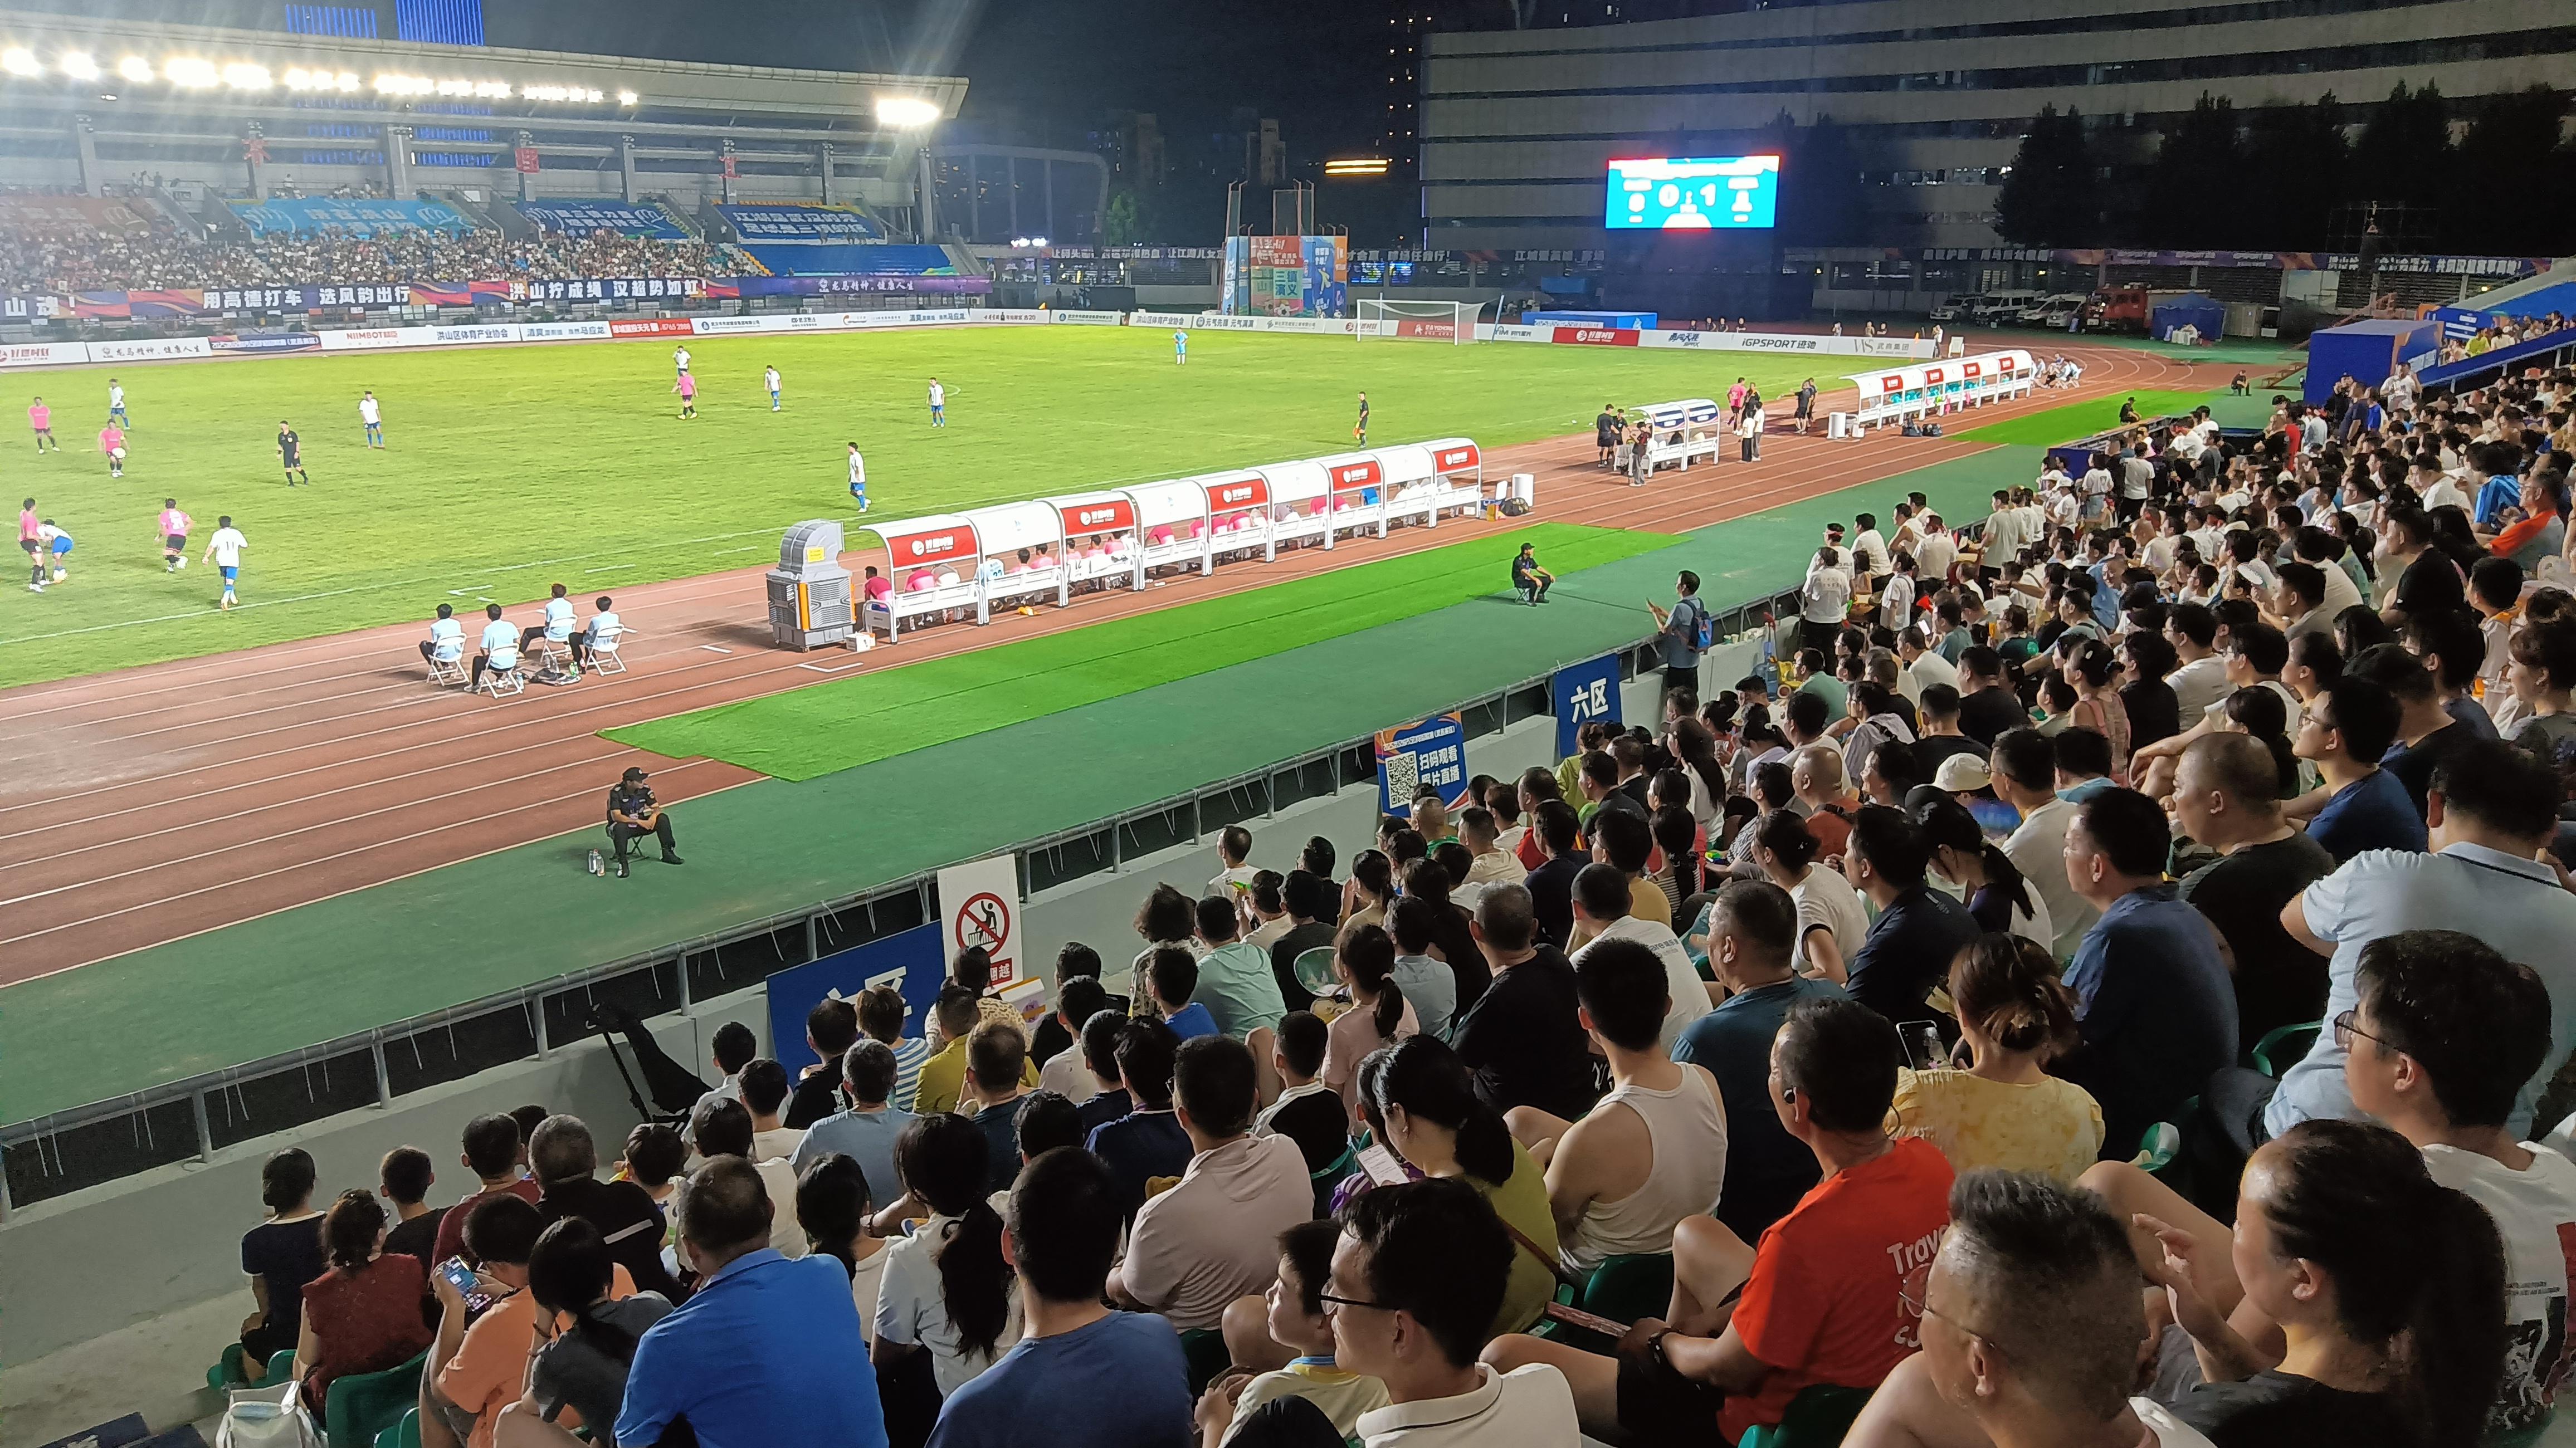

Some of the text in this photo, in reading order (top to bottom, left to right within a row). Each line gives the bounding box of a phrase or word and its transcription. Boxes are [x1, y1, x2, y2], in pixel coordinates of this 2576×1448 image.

[203, 286, 411, 310] 用高德打车 选风韵出行
[509, 280, 602, 300] 洪山拧成绳
[437, 328, 508, 341] 洪山区体育产业协会
[1570, 677, 1608, 723] 六区
[1419, 745, 1458, 771] 扫码观看
[1421, 765, 1460, 786] 照片直播
